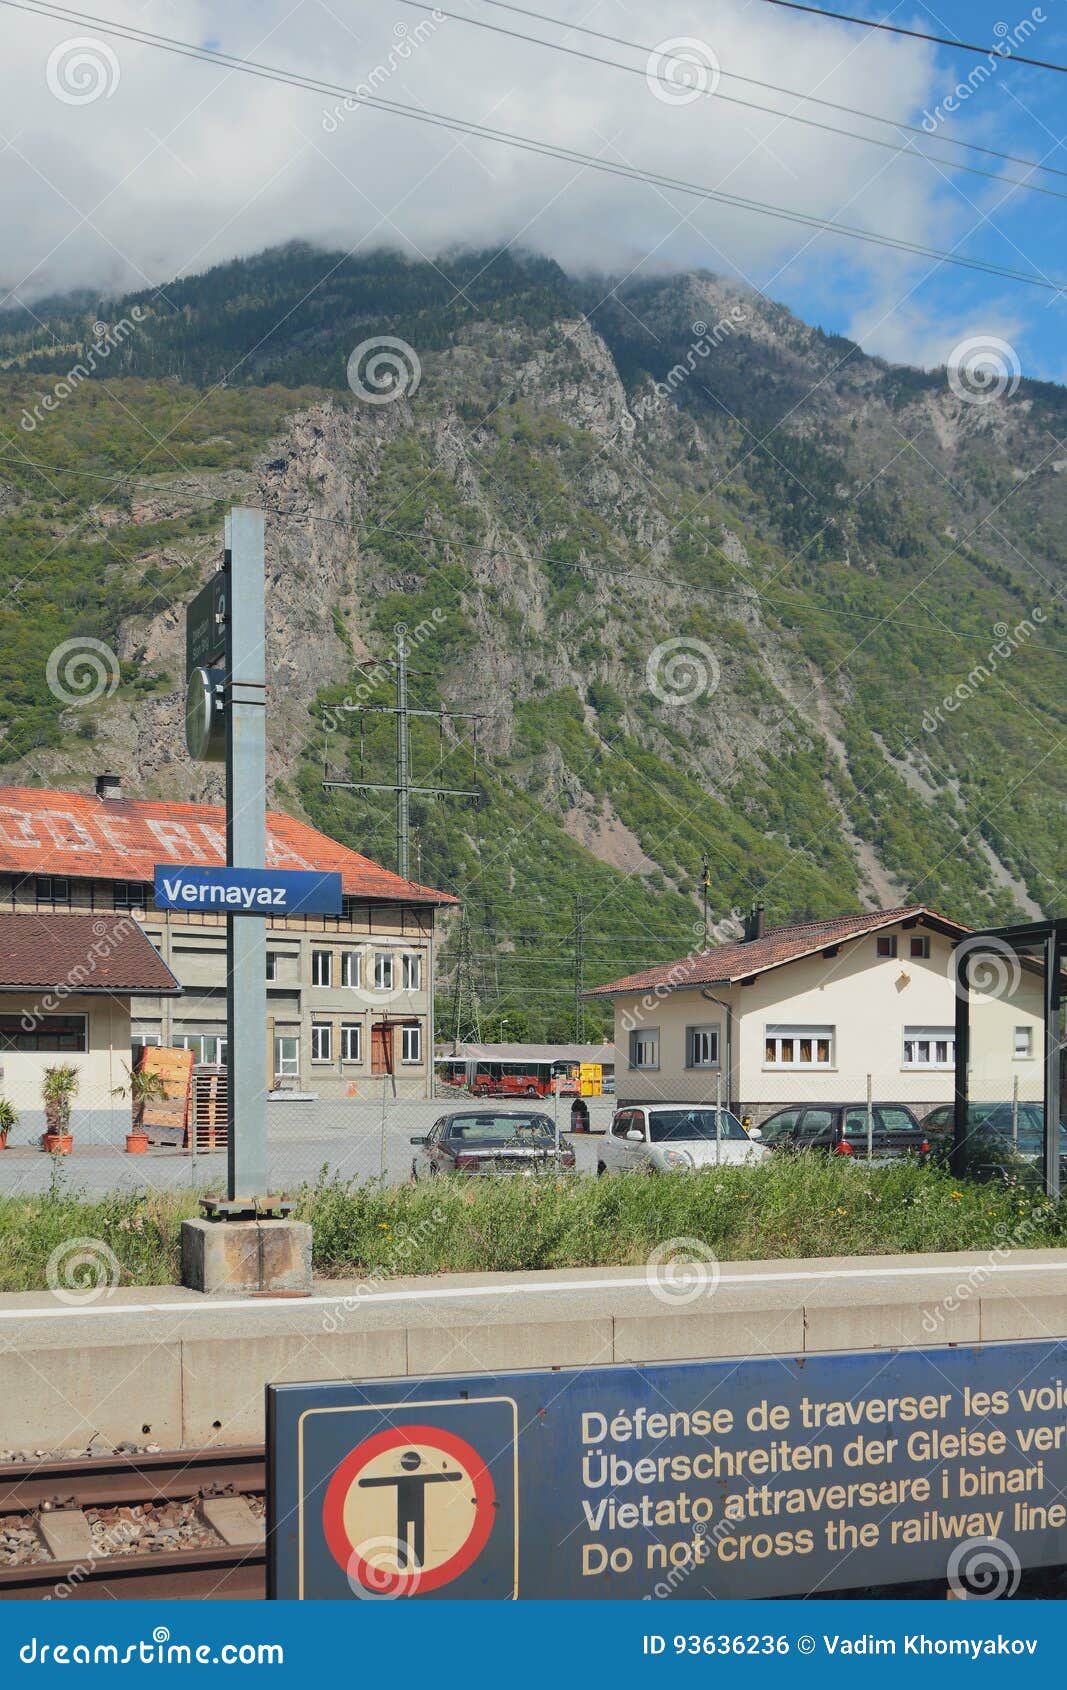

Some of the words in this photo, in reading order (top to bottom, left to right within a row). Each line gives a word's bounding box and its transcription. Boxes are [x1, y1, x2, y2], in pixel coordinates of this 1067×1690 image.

[162, 879, 287, 909] Vernayaz
[581, 1407, 734, 1445] Défense
[746, 1400, 791, 1432] de
[800, 1394, 952, 1428] traverser
[964, 1386, 1010, 1417] les
[1018, 1379, 1067, 1412] voi
[581, 1440, 833, 1489] Überschreiten
[843, 1435, 899, 1467] der
[907, 1427, 1007, 1461] Gleise
[1016, 1425, 1067, 1452] ver
[581, 1492, 714, 1532] Vietato
[724, 1477, 931, 1520] attraversare
[942, 1469, 949, 1499] i
[959, 1460, 1044, 1498] binari
[581, 1543, 634, 1576] Do
[647, 1533, 706, 1569] not
[717, 1529, 815, 1562] cross
[825, 1519, 880, 1551] the
[891, 1510, 1005, 1544] railway
[1014, 1502, 1067, 1532] line
